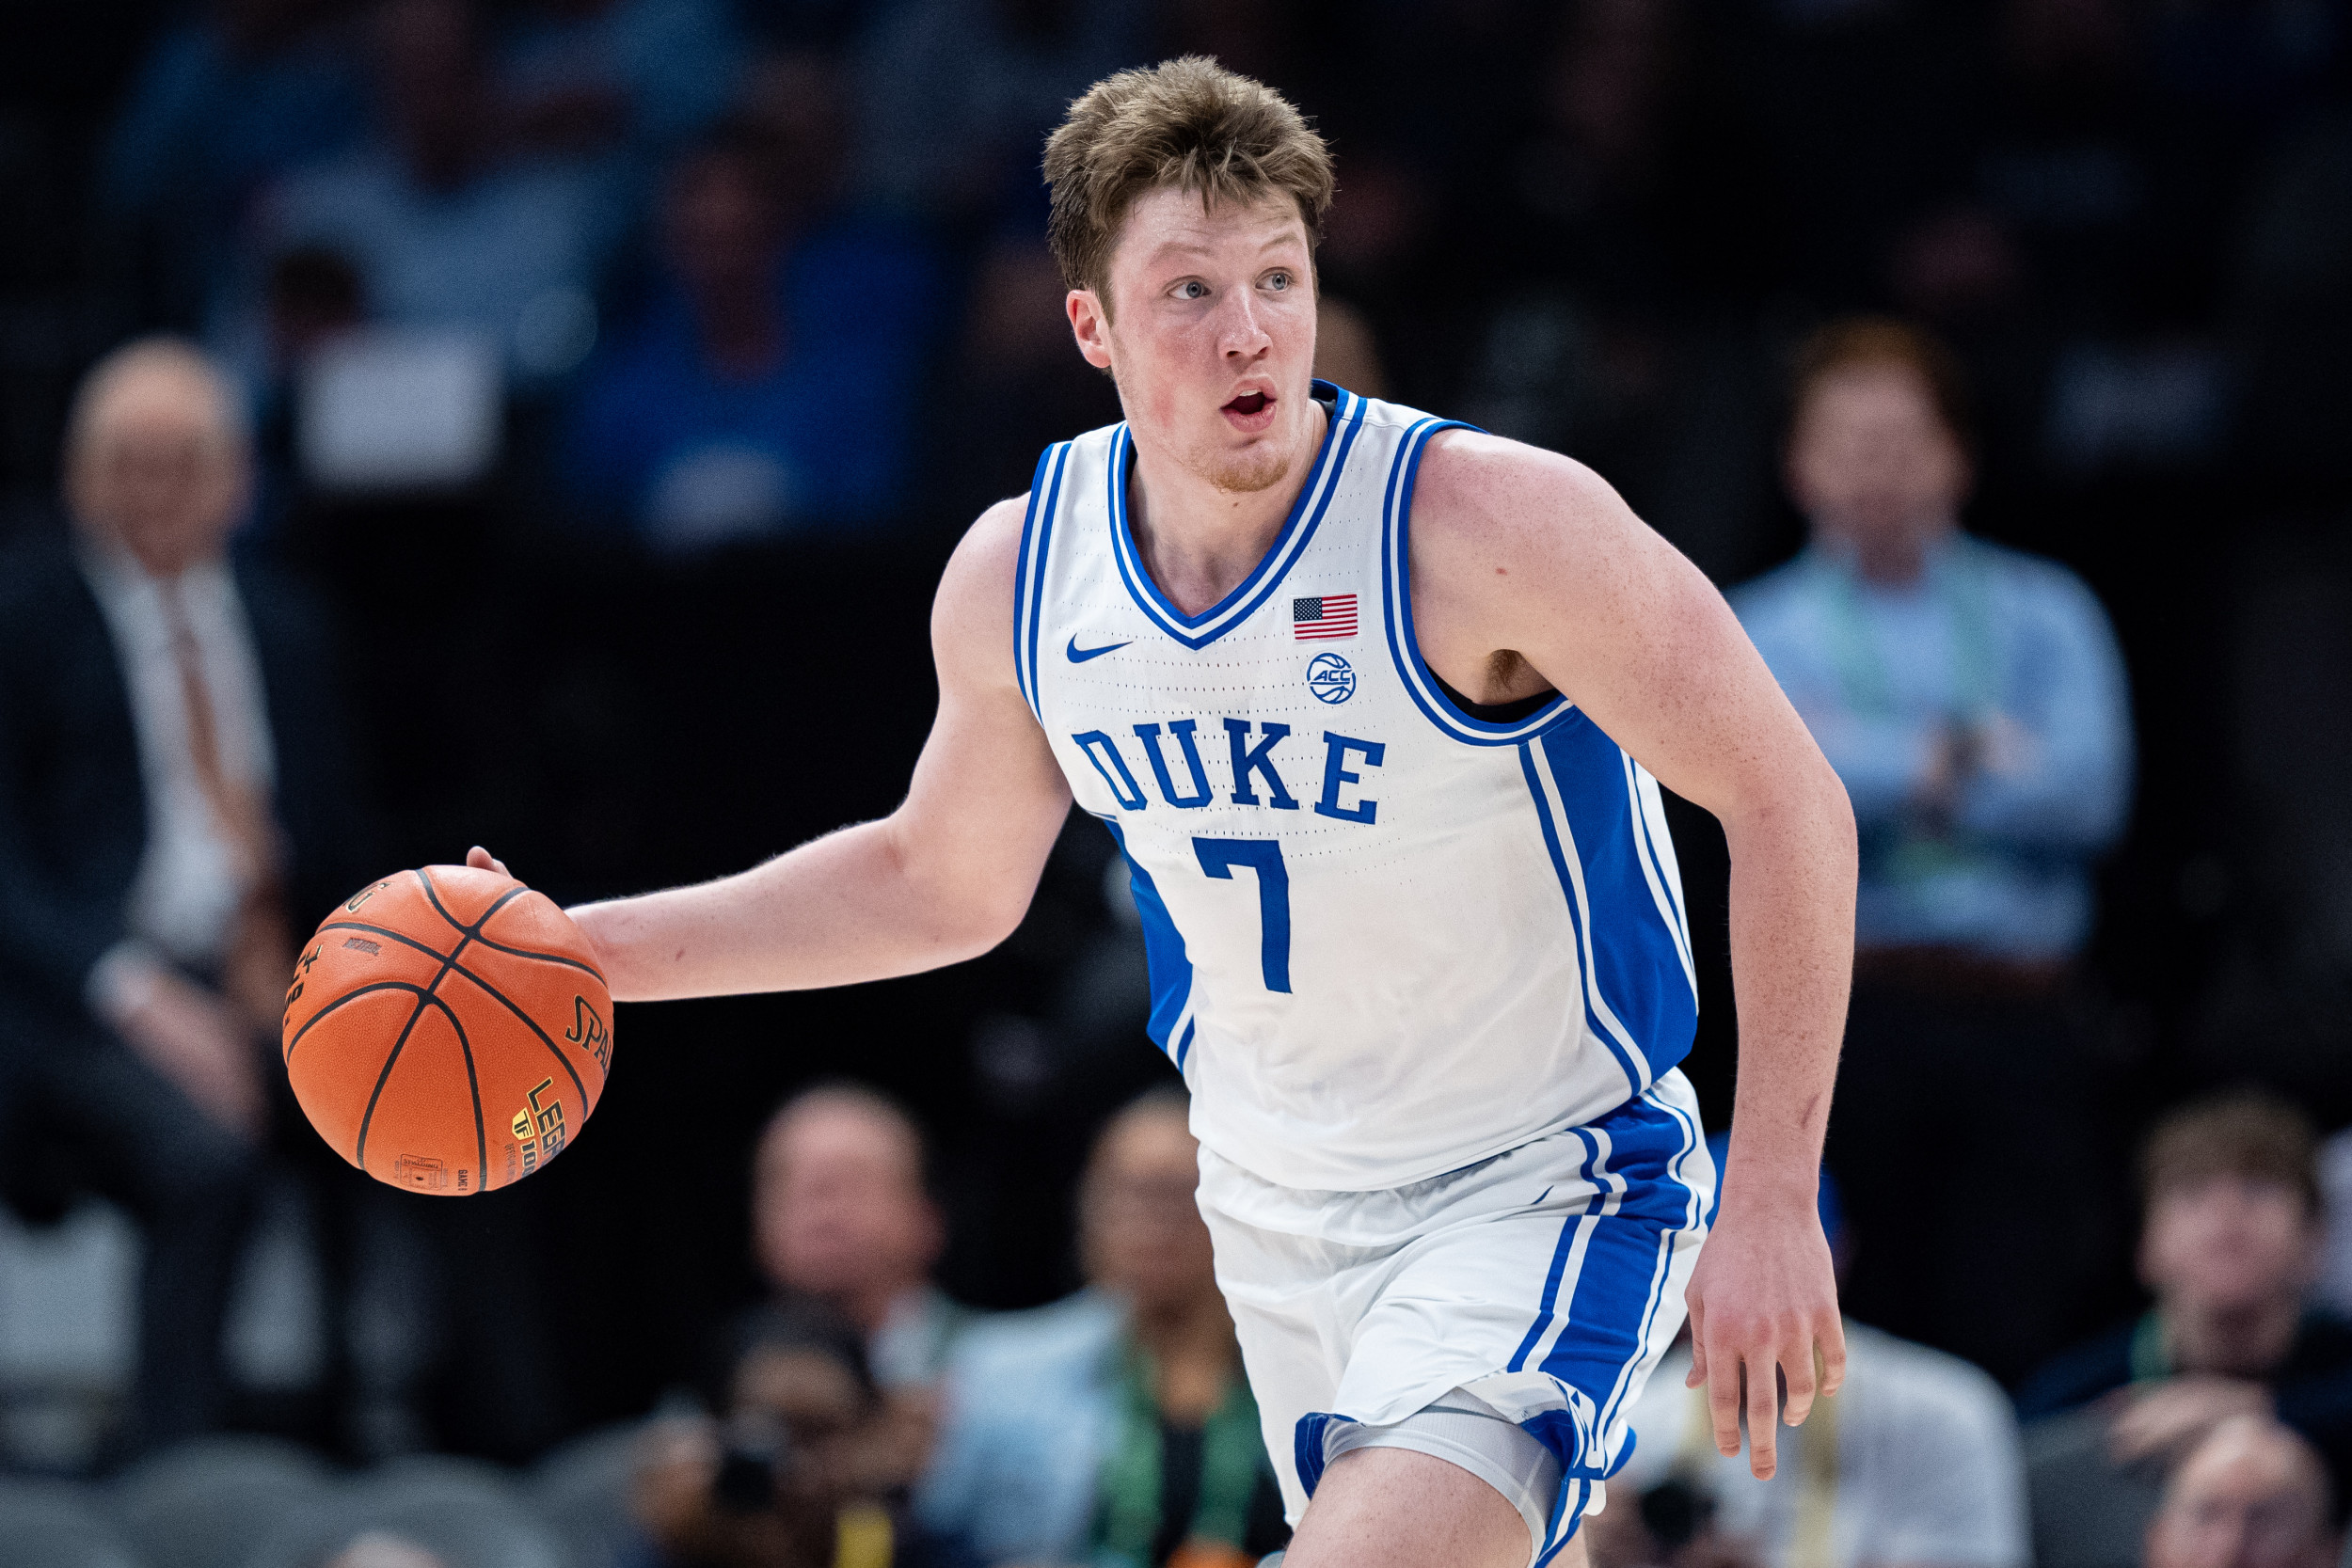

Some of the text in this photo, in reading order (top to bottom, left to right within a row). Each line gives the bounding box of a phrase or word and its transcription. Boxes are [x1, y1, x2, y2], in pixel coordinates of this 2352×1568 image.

[1313, 669, 1353, 685] ACC
[1071, 718, 1386, 825] DUKE
[1191, 837, 1293, 993] 7
[514, 1109, 533, 1138] TF
